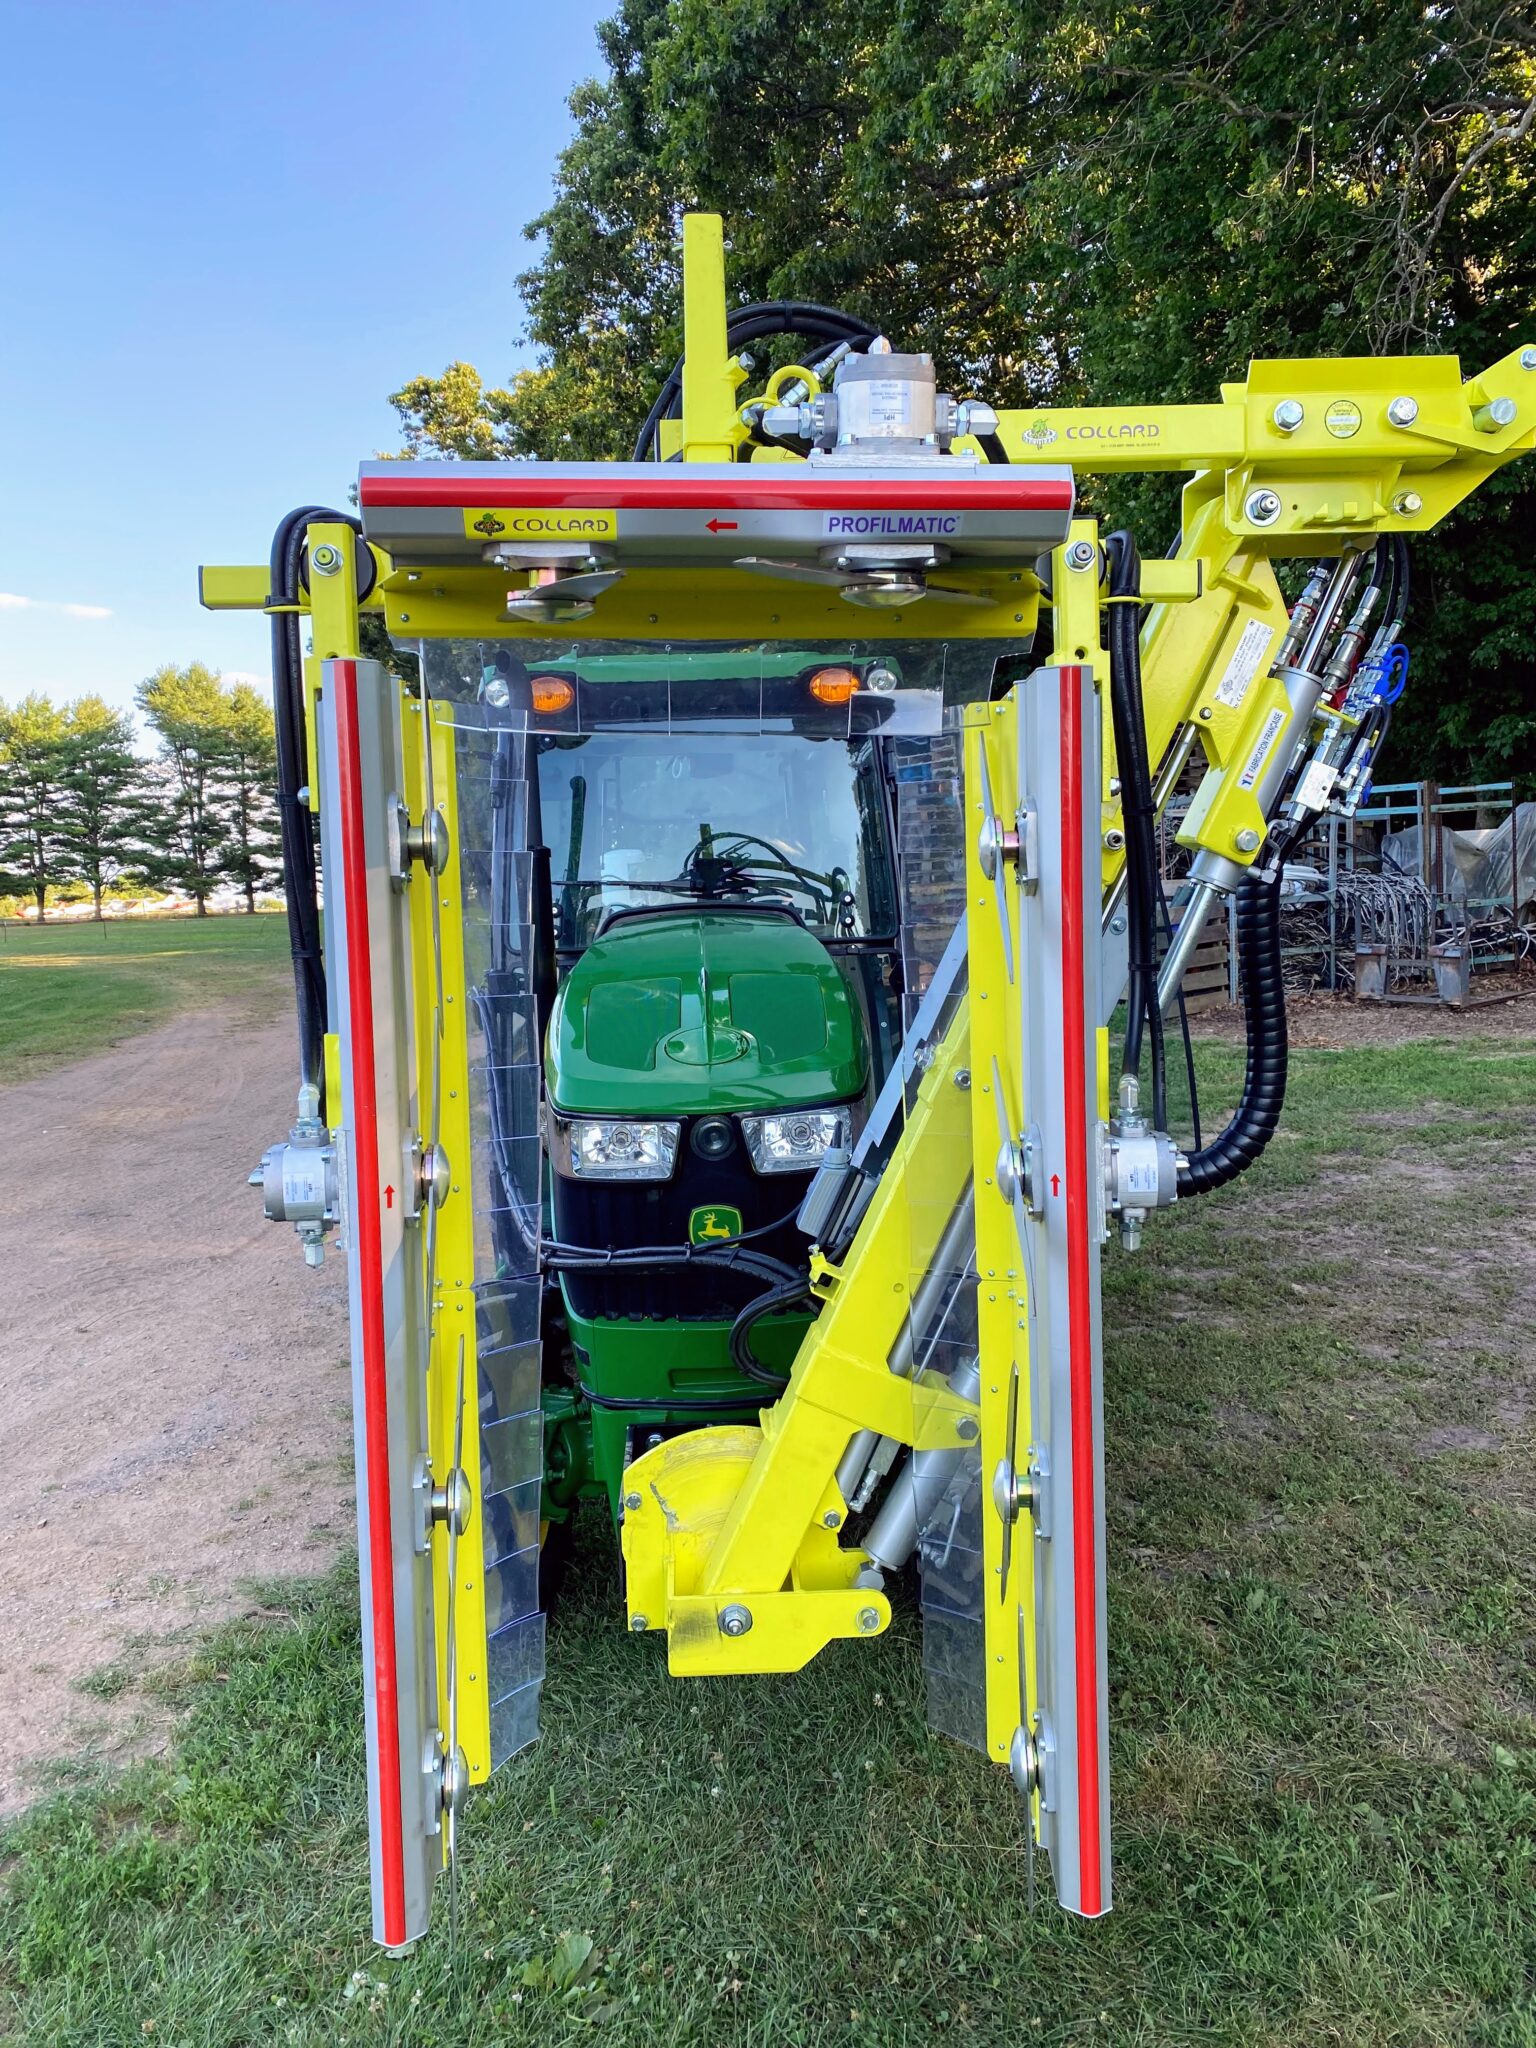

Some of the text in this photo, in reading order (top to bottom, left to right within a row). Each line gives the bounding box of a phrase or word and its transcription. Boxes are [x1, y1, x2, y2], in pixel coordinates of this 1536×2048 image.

[1066, 424, 1160, 440] COLLARD
[512, 518, 609, 532] COLLARD
[828, 517, 956, 533] PROFILMATIC
[1248, 741, 1269, 773] FABRICATION
